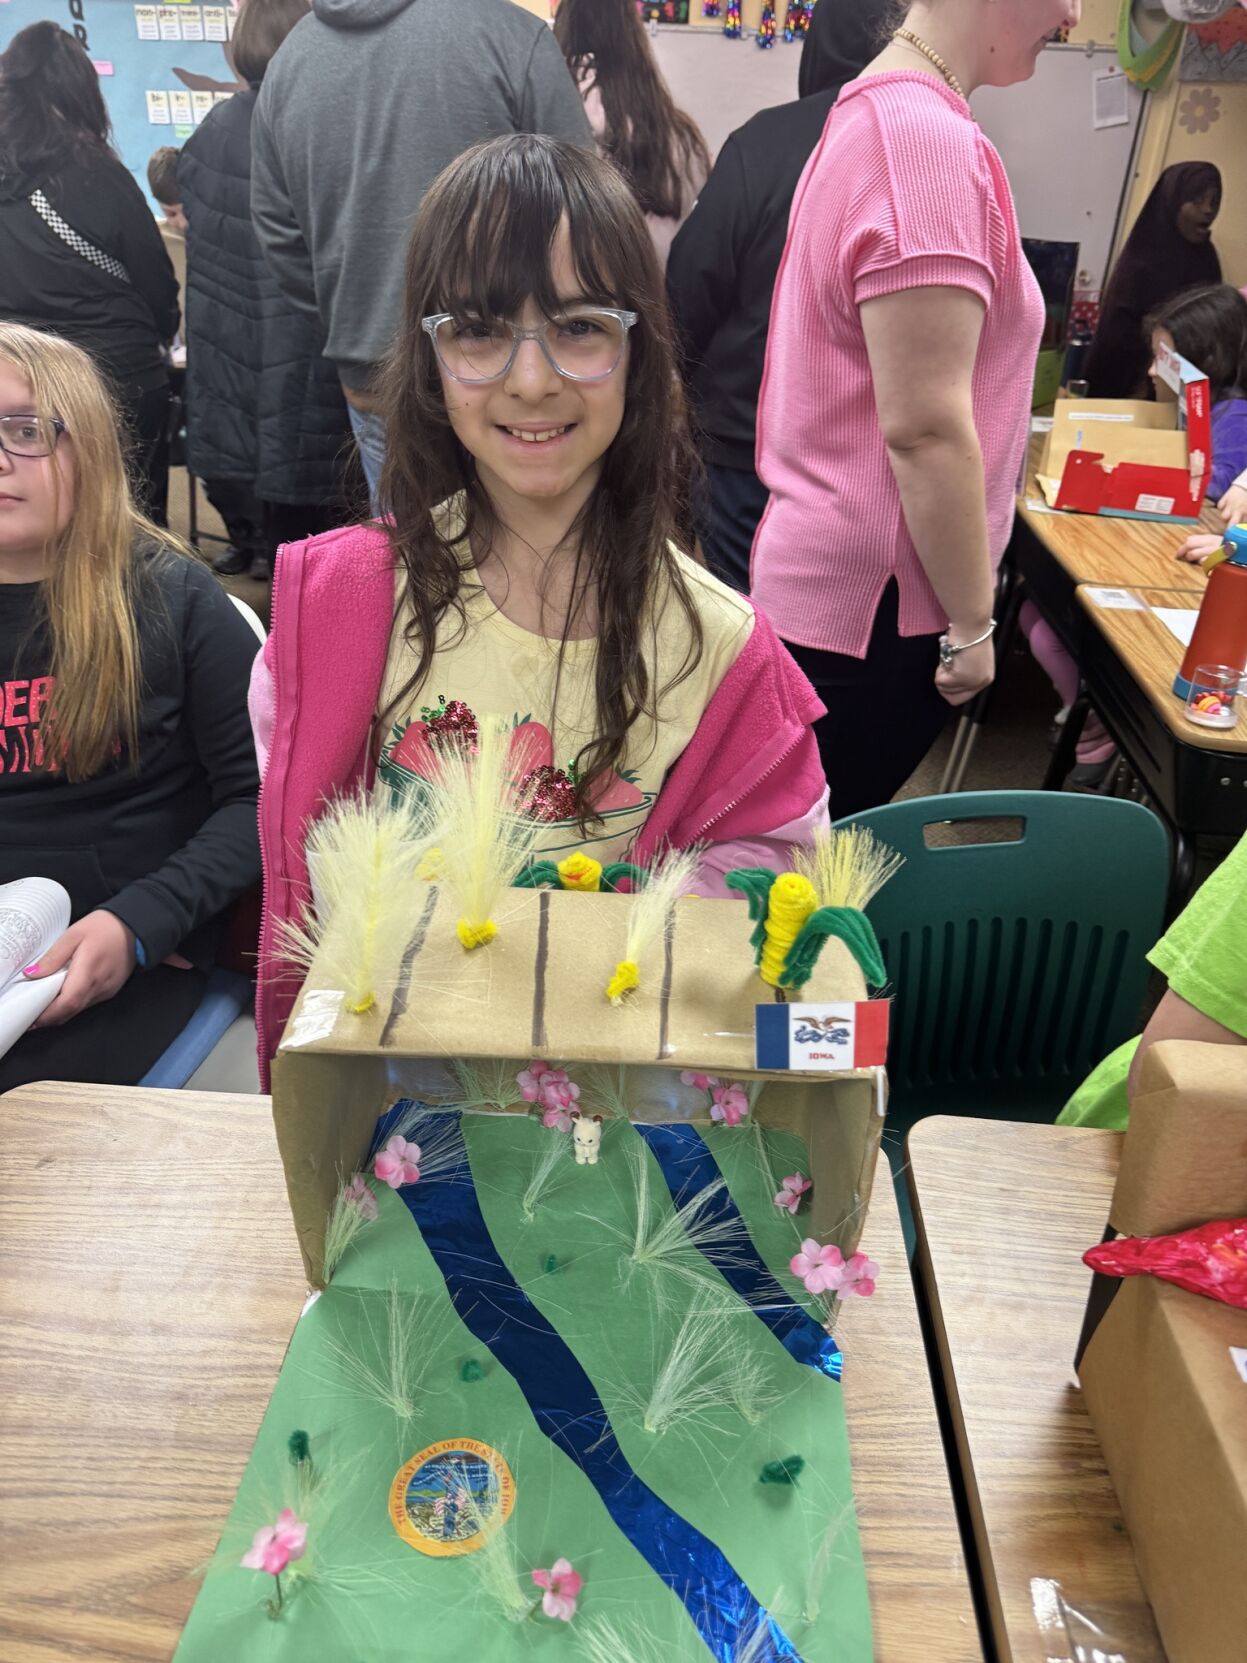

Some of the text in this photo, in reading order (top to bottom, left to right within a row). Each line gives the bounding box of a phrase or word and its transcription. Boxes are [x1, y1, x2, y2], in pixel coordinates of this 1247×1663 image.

[809, 1052, 834, 1060] IOWA
[443, 1441, 458, 1450] OF
[460, 1441, 481, 1452] THE
[415, 1447, 440, 1464] SEAL
[396, 1465, 415, 1500] GREAT
[502, 1477, 510, 1490] OF
[395, 1504, 405, 1525] THE
